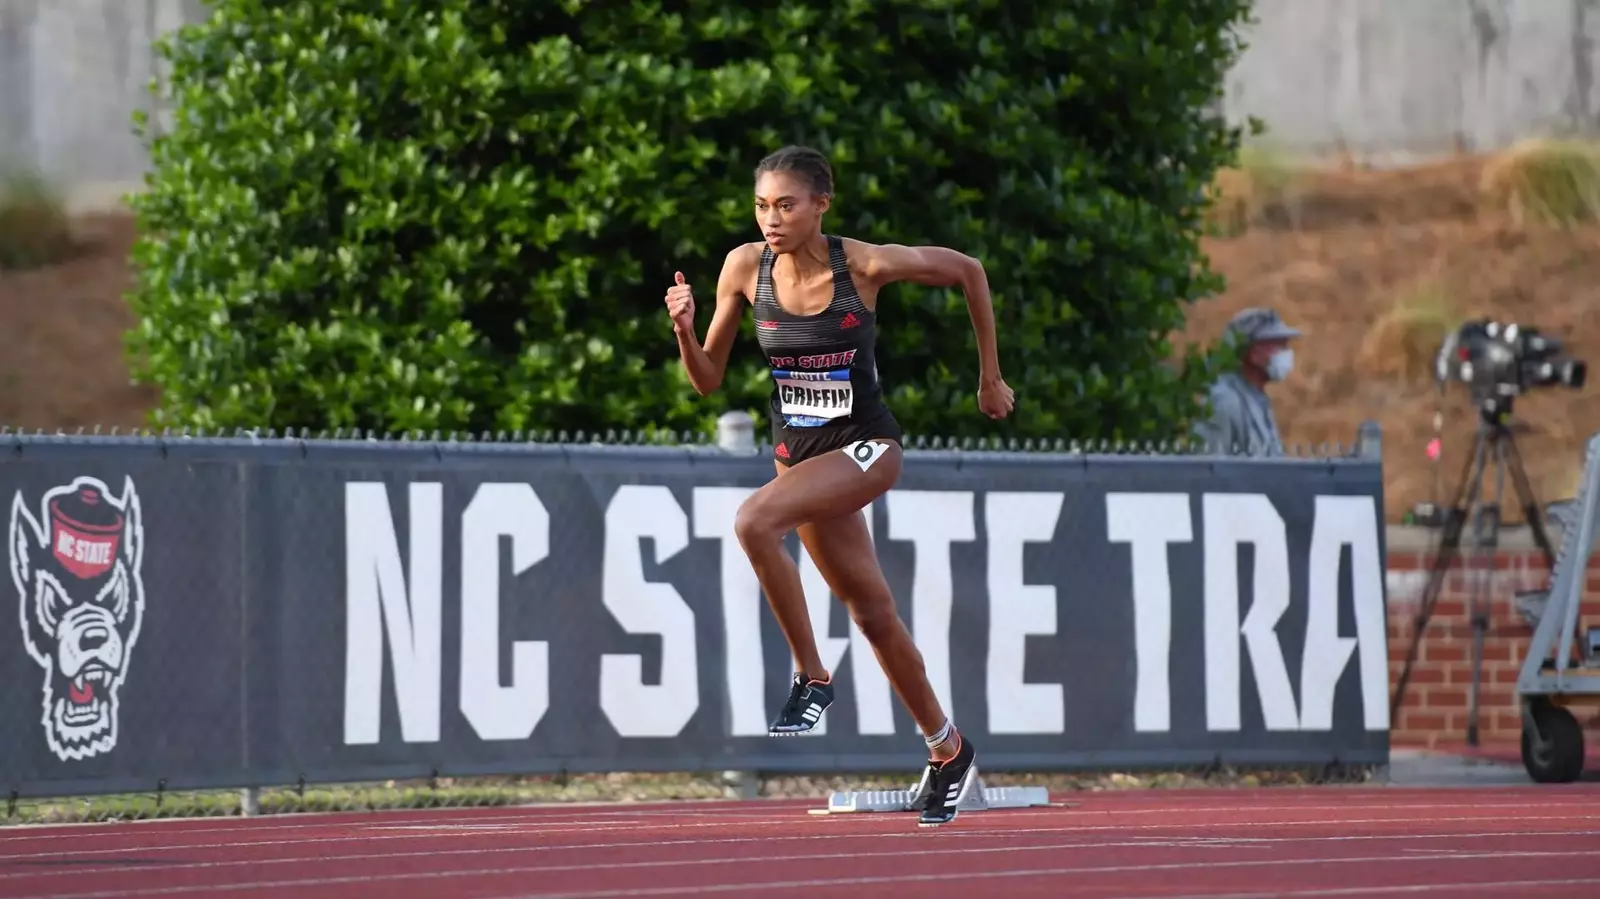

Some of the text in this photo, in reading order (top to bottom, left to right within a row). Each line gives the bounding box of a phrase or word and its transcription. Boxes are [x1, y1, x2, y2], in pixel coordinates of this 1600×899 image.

[770, 349, 858, 369] NC STATE
[781, 385, 850, 409] GRIFFIN
[853, 440, 874, 463] 6
[58, 530, 112, 565] NC STATE
[344, 482, 550, 744] NC
[1106, 492, 1390, 732] TRA
